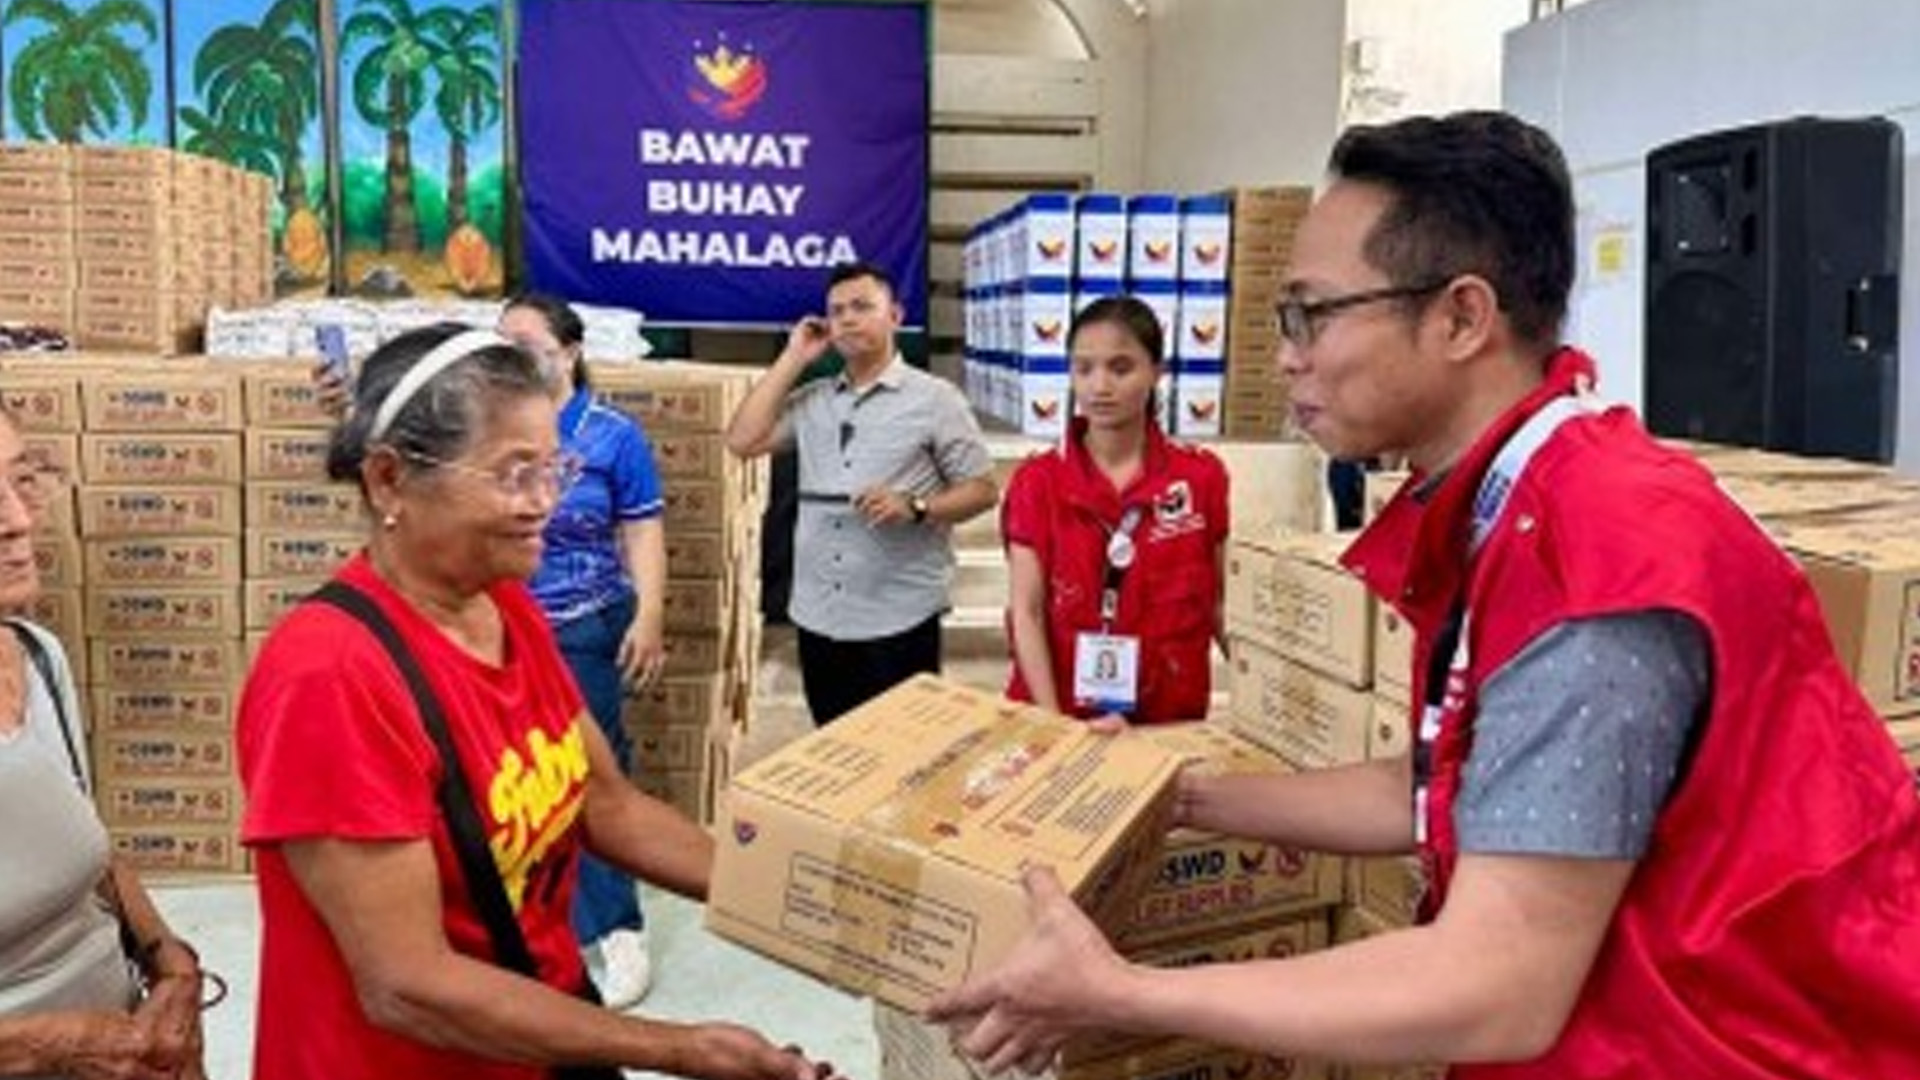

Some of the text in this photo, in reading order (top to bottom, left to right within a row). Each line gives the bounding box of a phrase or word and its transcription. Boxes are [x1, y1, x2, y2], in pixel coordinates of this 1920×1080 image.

[640, 129, 809, 168] BAWAT
[647, 180, 804, 216] BUHAY
[591, 228, 857, 267] MAHALAGA
